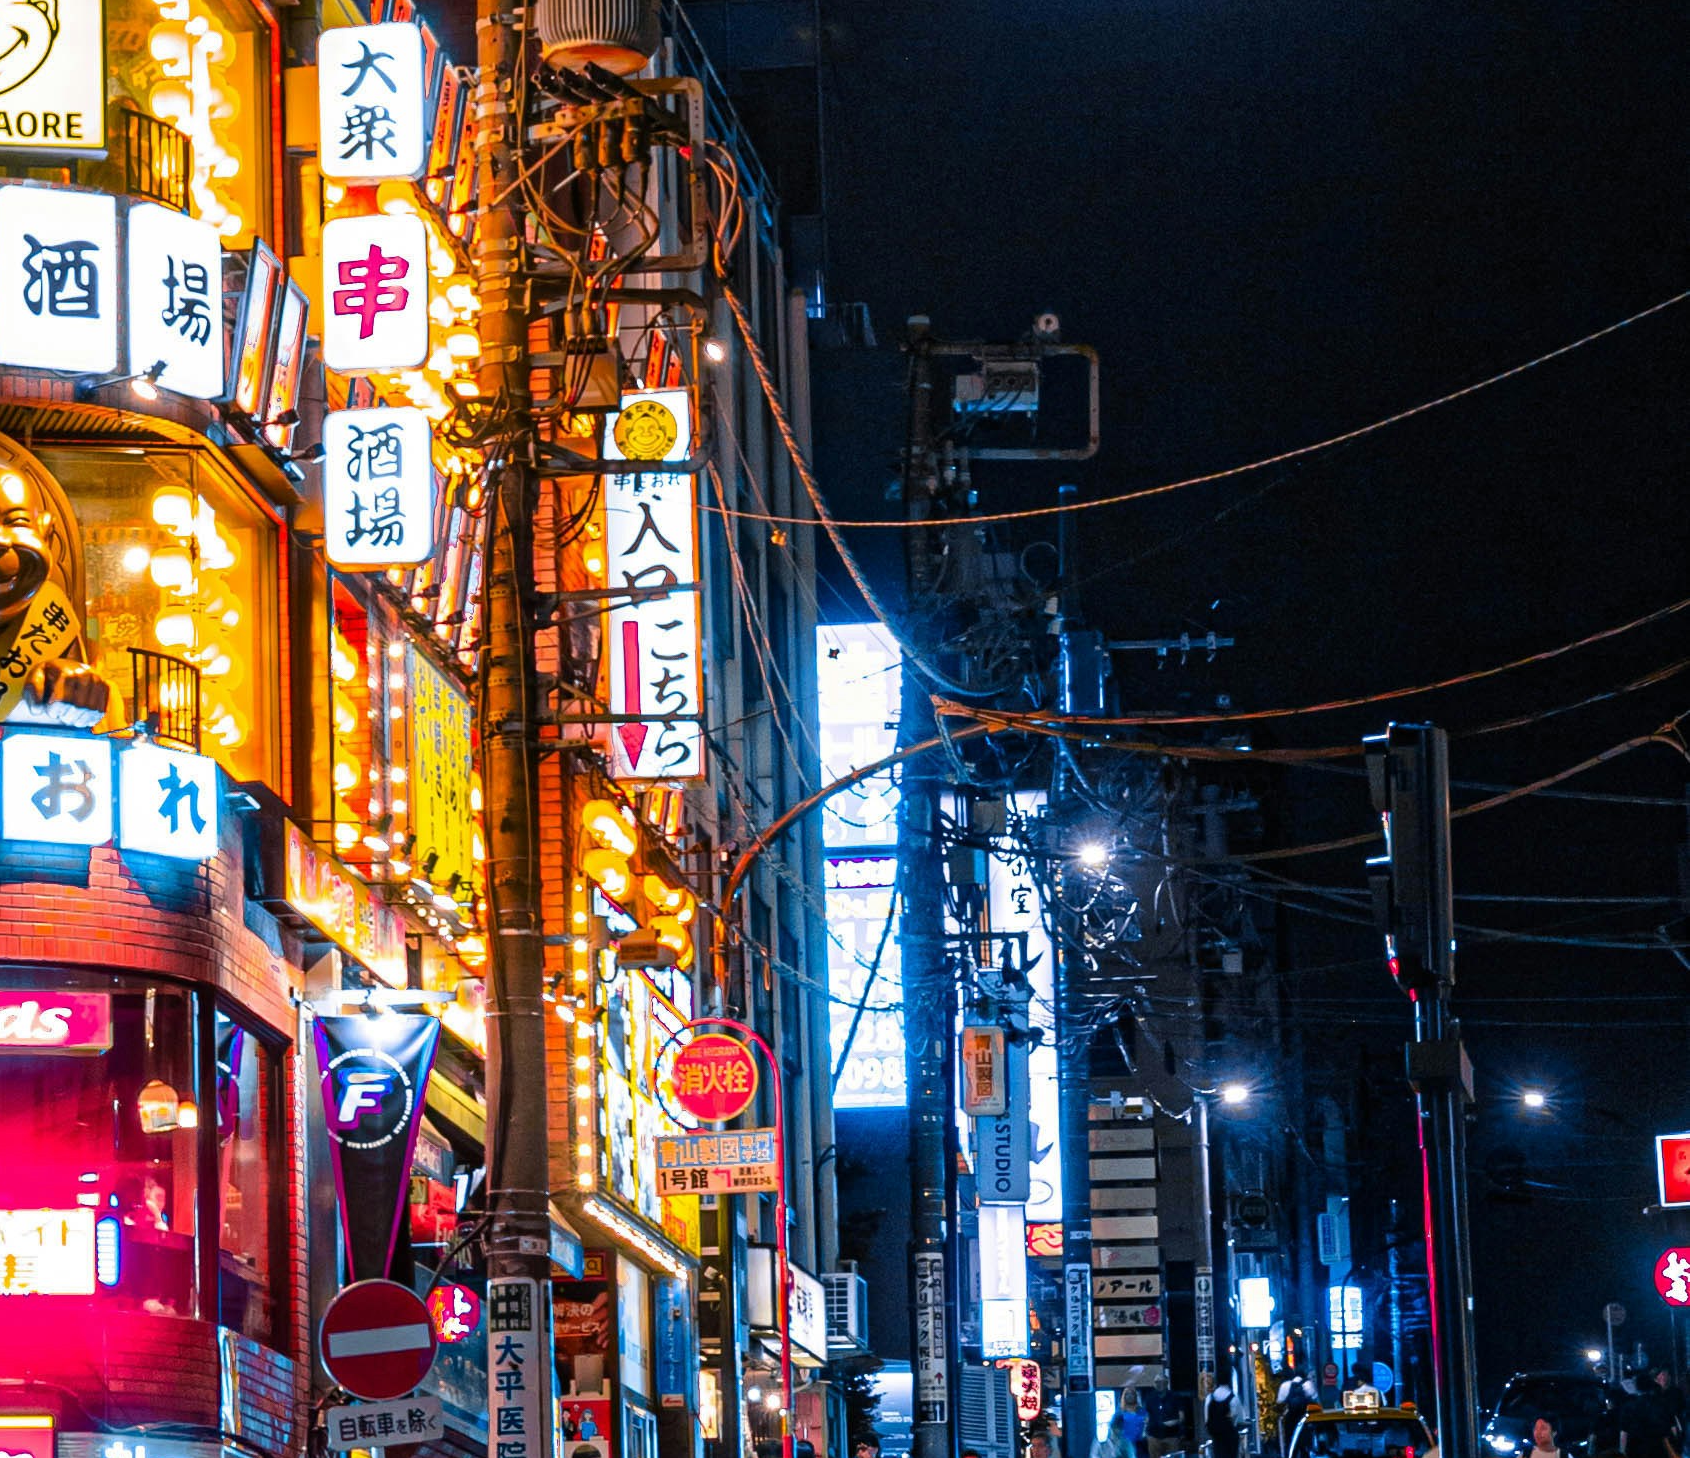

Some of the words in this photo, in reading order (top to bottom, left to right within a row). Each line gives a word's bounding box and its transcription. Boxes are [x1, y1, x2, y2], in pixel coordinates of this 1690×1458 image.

[332, 243, 409, 340] 串
[346, 423, 407, 548] 酒場
[650, 619, 691, 767] こちら
[678, 1061, 750, 1095] 消火栓
[660, 1167, 709, 1191] 1号館
[994, 1123, 1011, 1194] STUDIO
[339, 1408, 438, 1442] 自転車を除く
